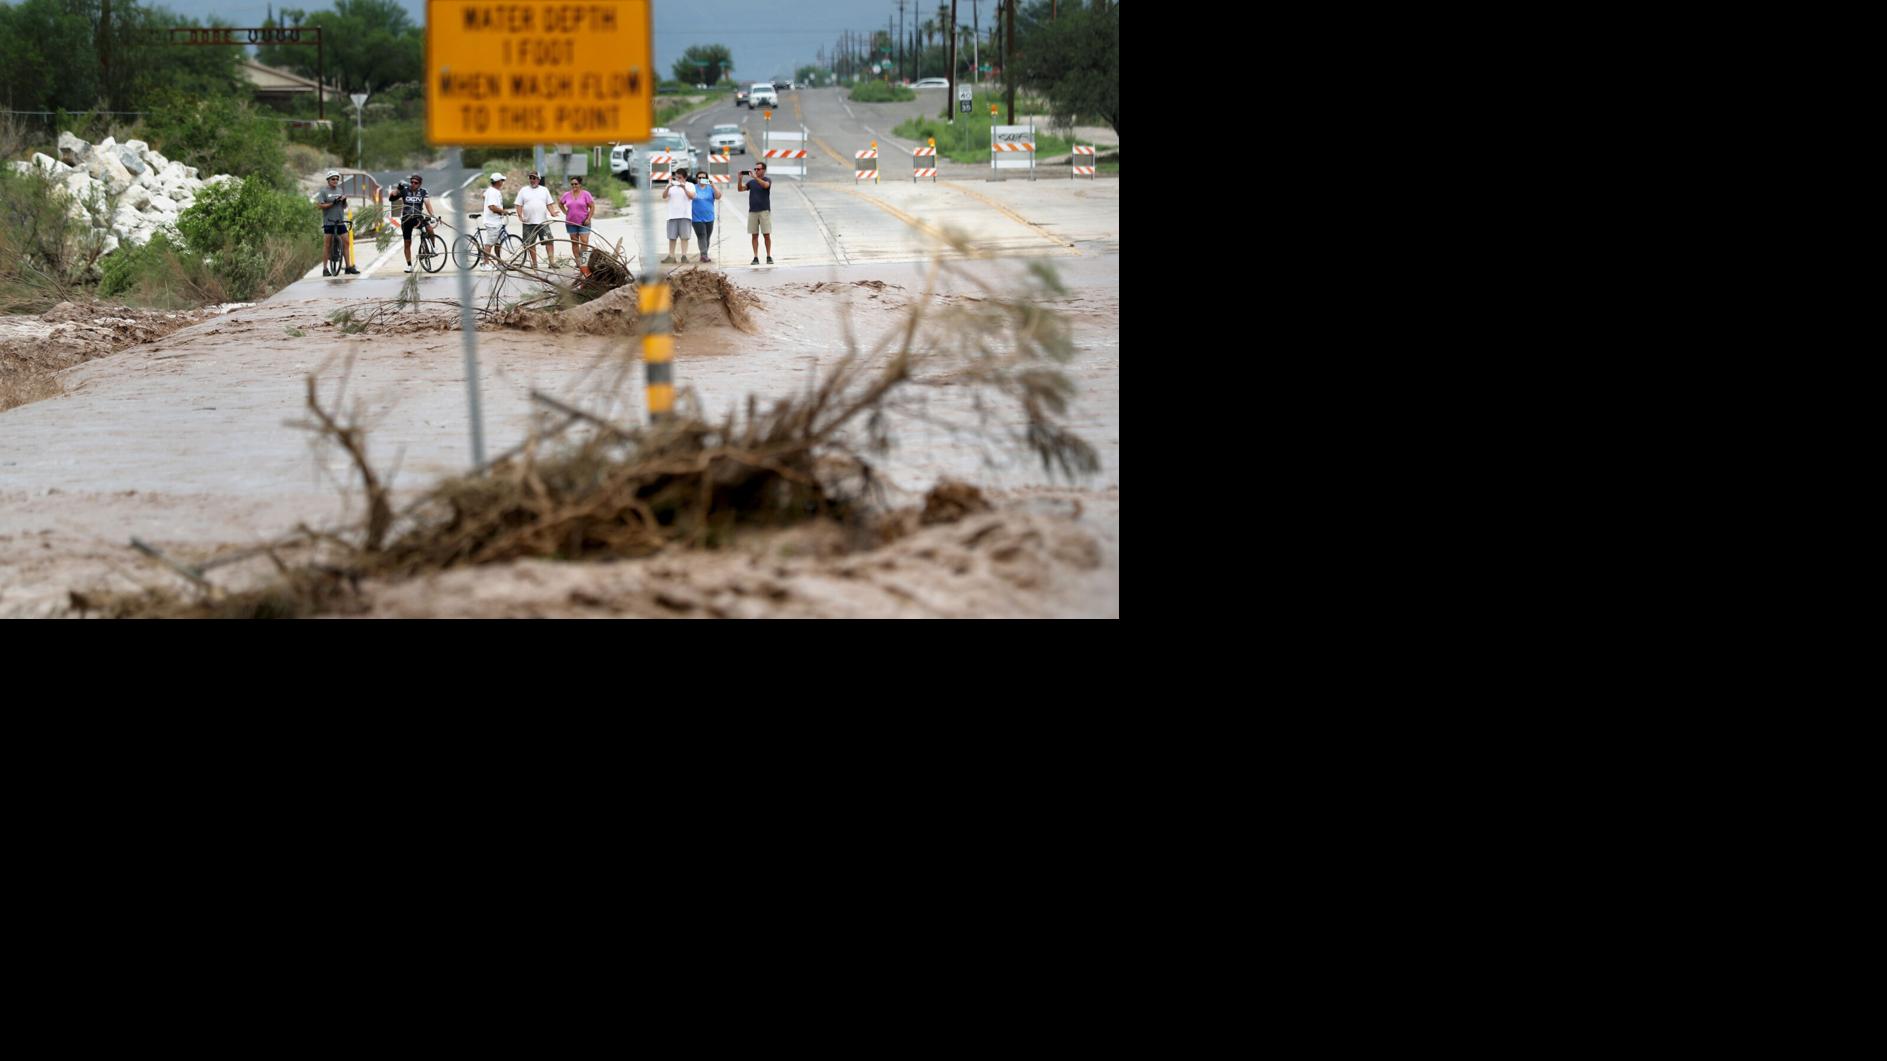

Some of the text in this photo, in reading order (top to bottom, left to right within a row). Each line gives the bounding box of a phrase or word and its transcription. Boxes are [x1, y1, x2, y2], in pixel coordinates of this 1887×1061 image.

[463, 6, 618, 33] WATER DEPTH
[518, 38, 574, 66] FOOT
[440, 72, 641, 100] WHEN WASH FLOW
[460, 104, 620, 133] TO THIS POINT
